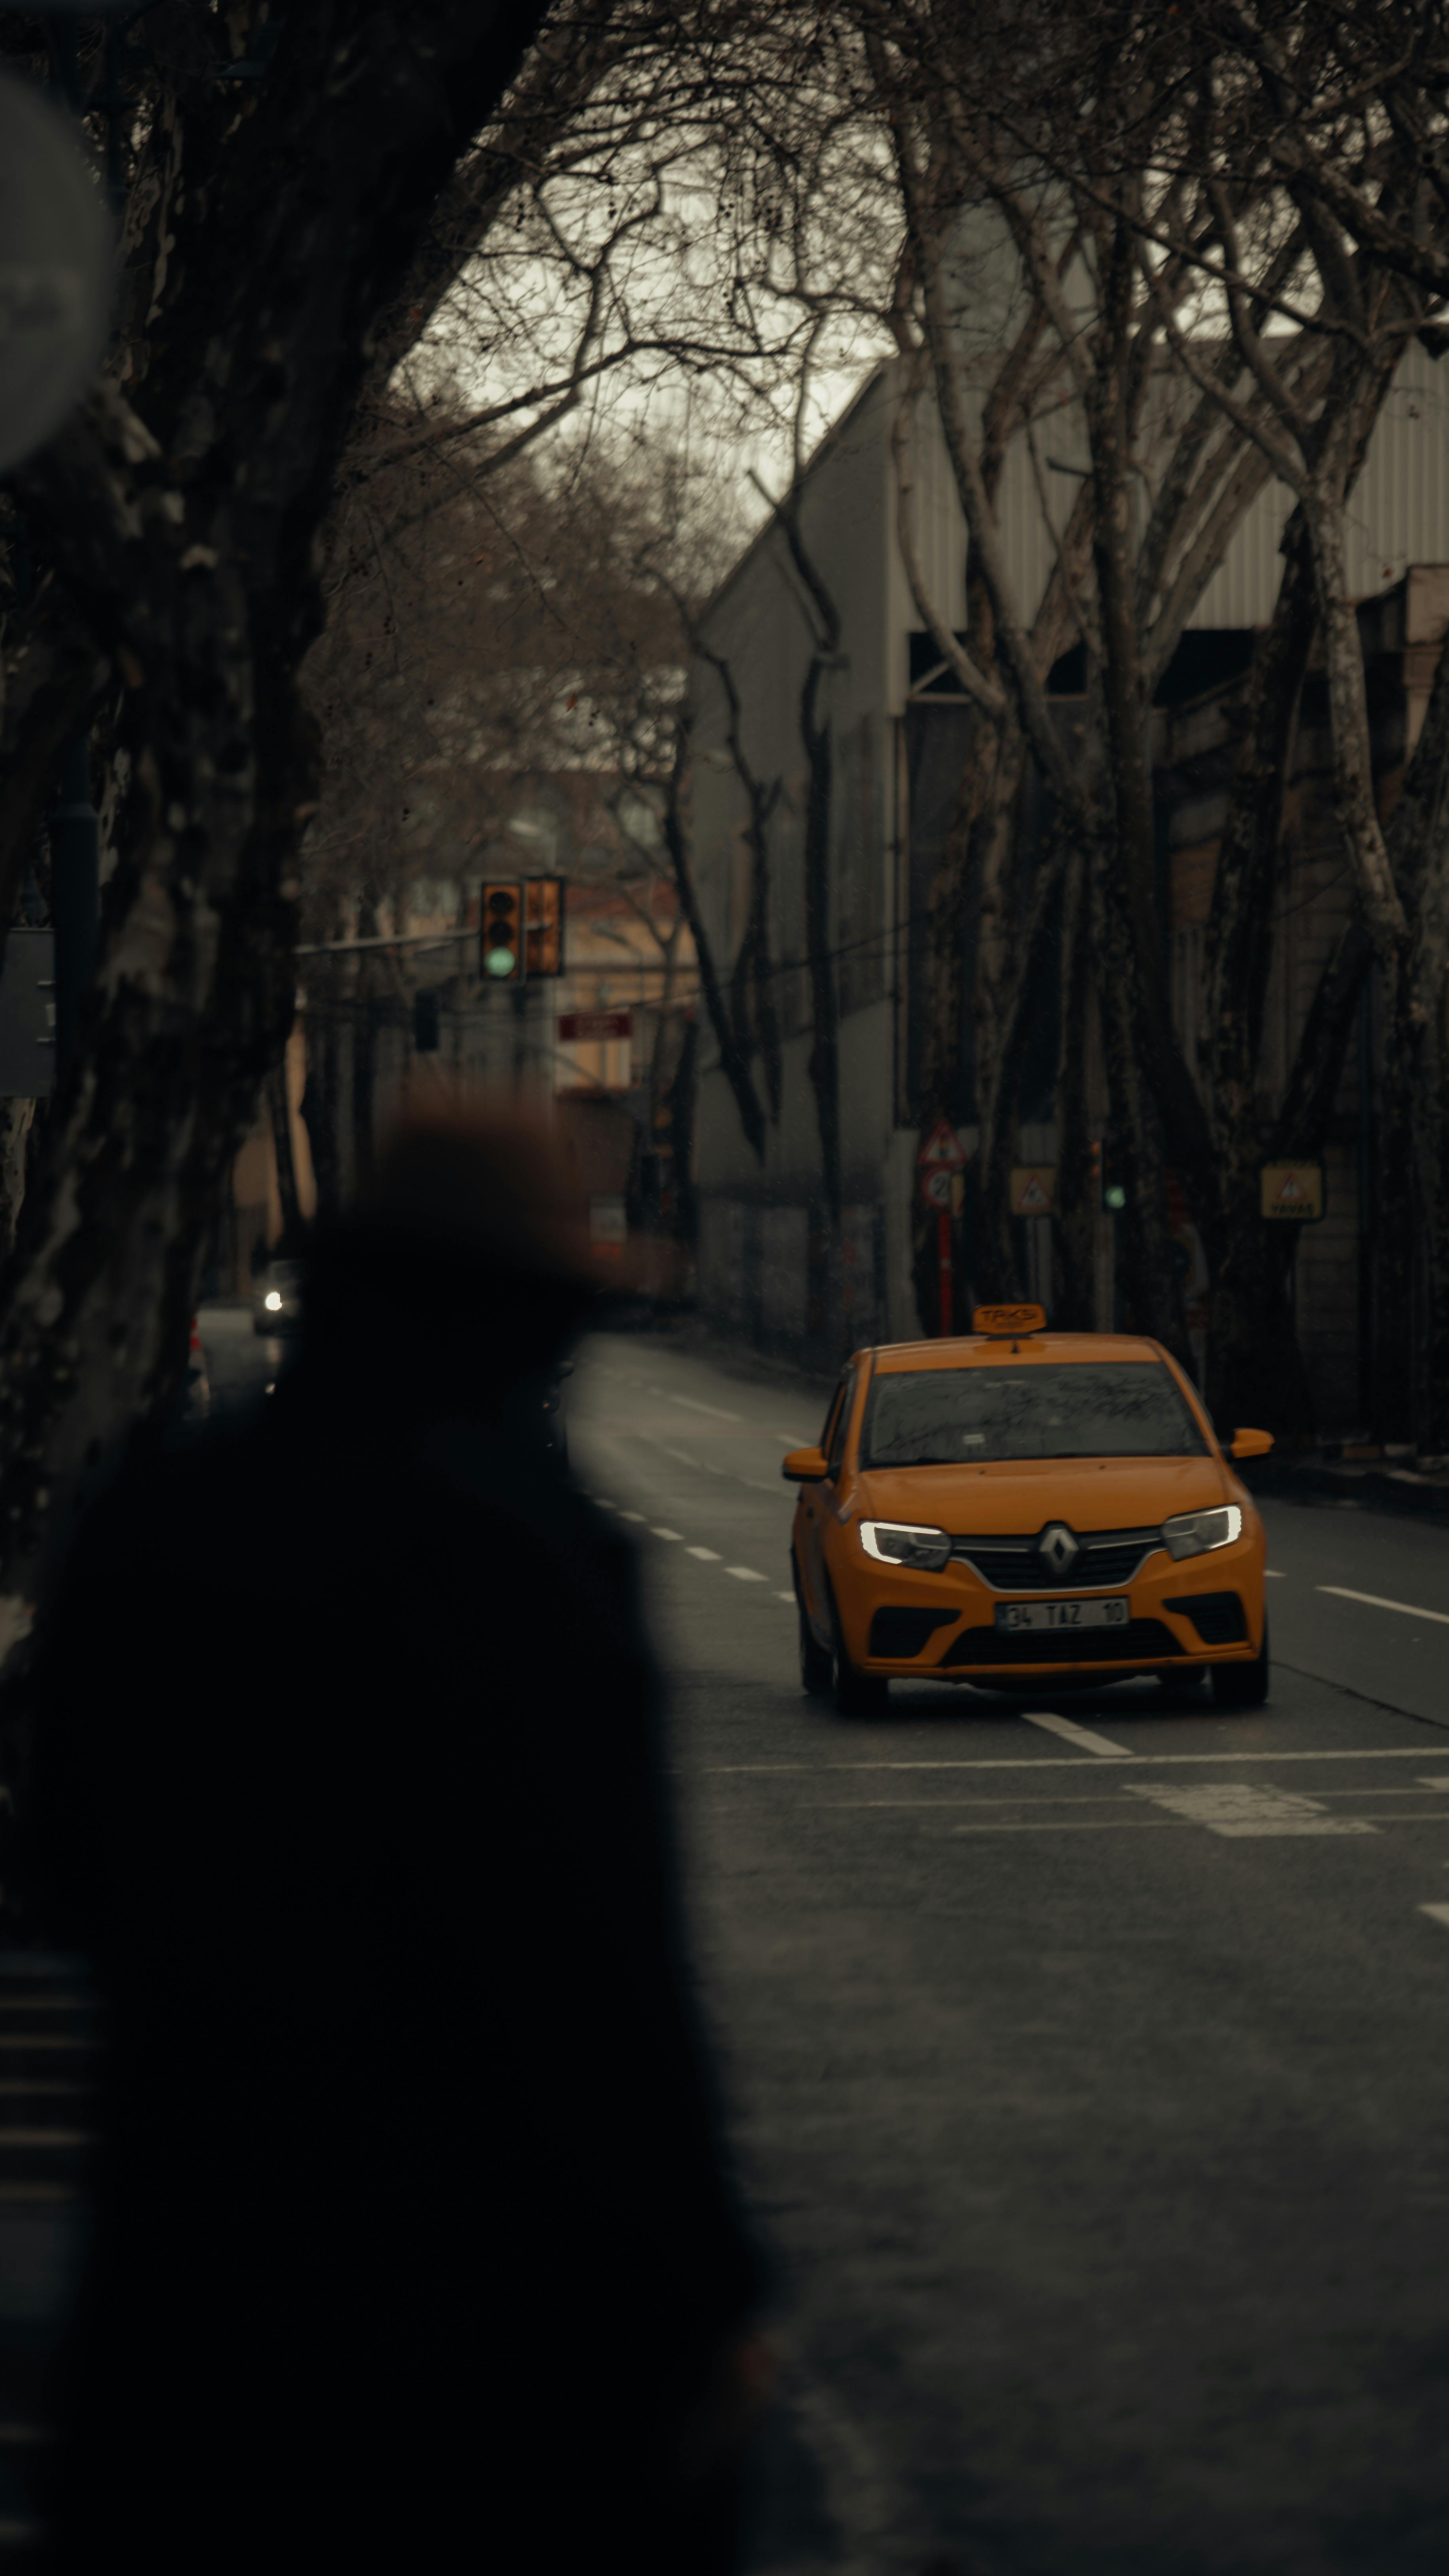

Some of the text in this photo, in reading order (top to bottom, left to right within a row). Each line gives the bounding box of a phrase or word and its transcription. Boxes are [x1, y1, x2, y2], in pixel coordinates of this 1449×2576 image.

[1009, 1607, 1032, 1627] 34
[1046, 1604, 1082, 1625] TAZ
[1103, 1602, 1124, 1623] 10
